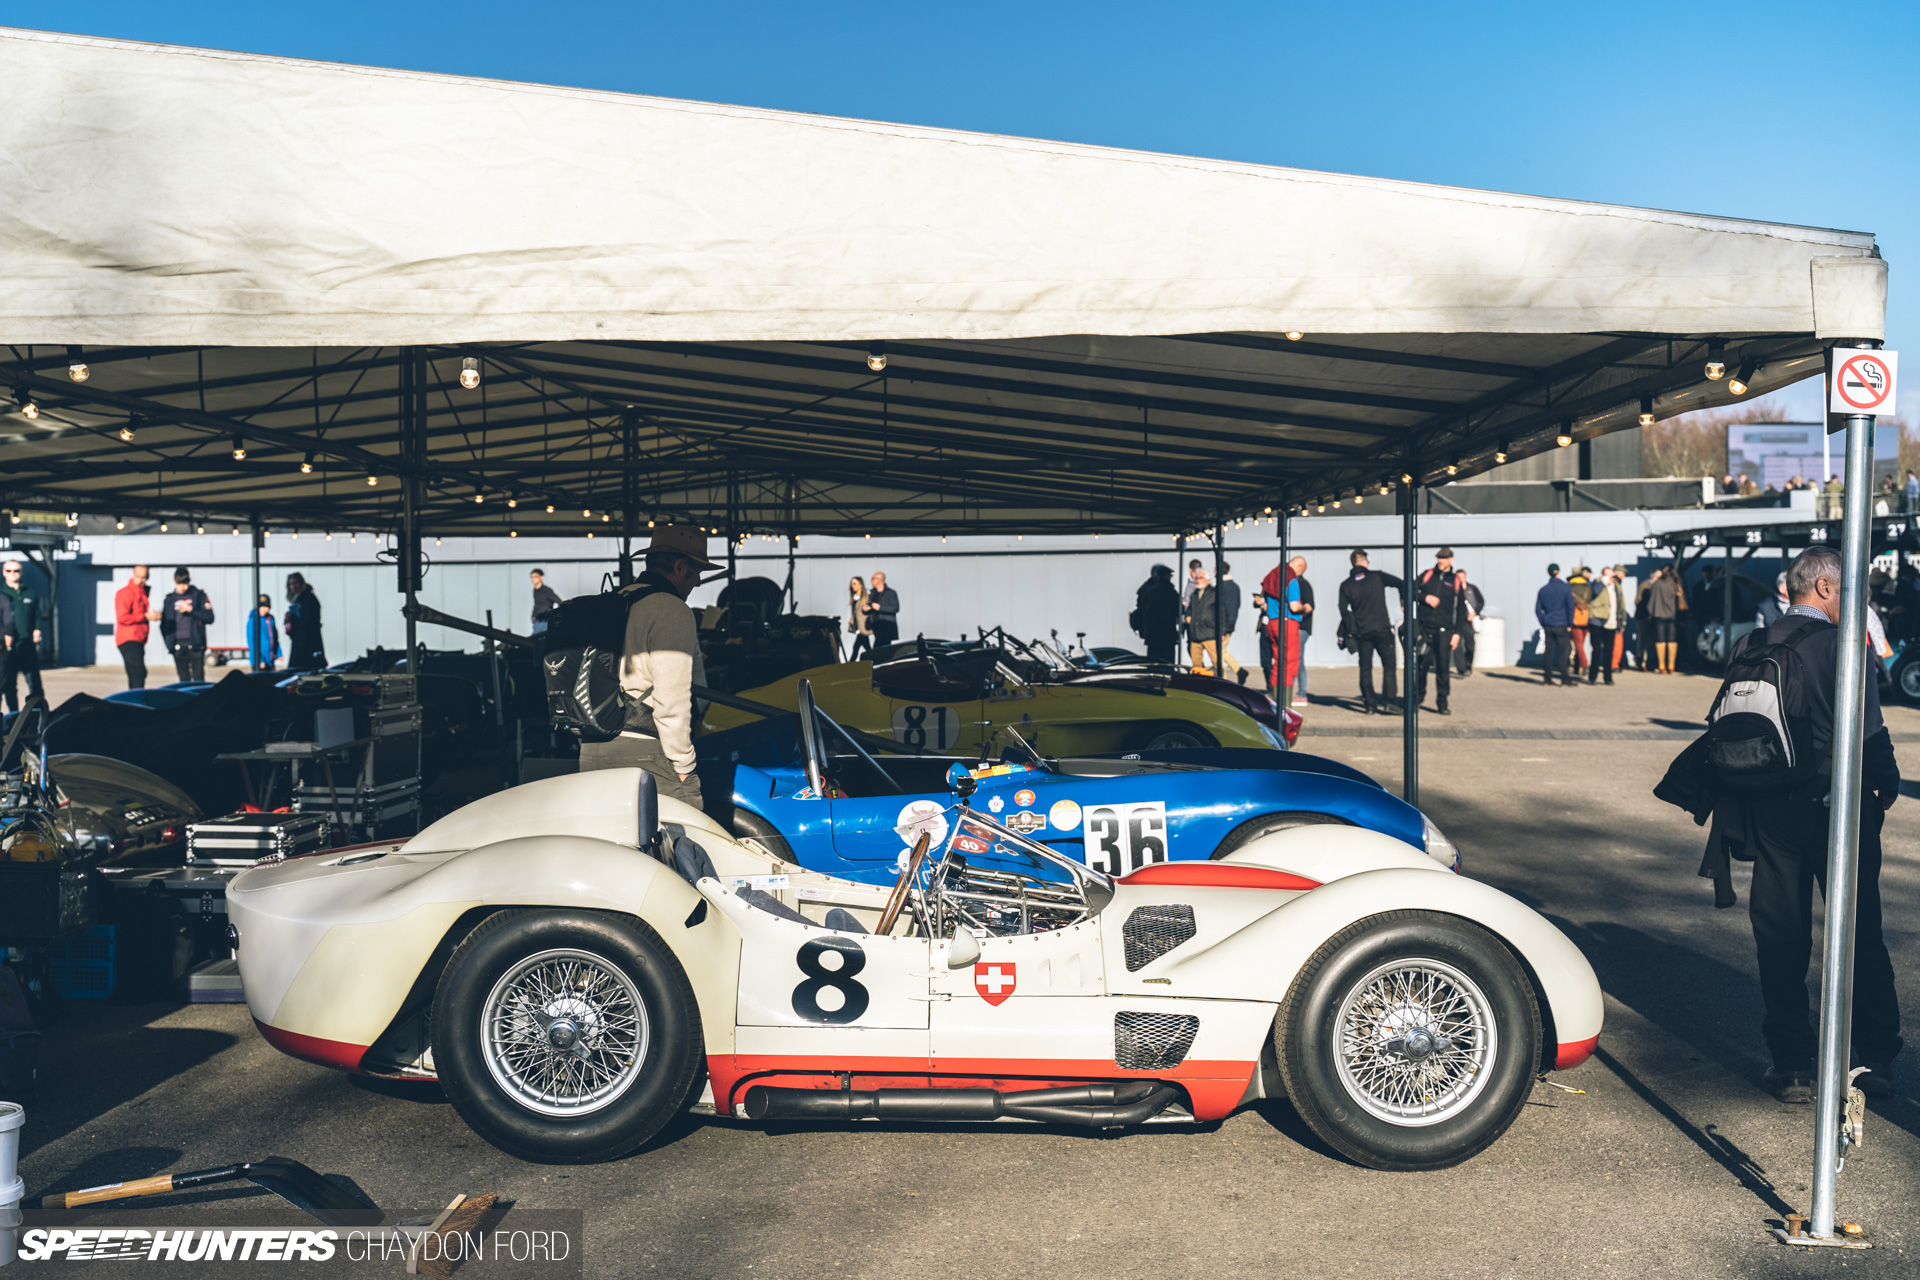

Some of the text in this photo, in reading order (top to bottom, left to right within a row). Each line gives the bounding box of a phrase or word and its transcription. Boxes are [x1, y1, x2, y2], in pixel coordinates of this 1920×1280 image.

[1746, 531, 1762, 543] 25
[1810, 527, 1827, 541] 26
[1887, 523, 1906, 537] 27
[1643, 538, 1658, 549] 23
[1692, 534, 1708, 547] 24
[902, 706, 948, 751] 81
[960, 839, 980, 851] 40
[1090, 807, 1165, 877] 36
[791, 936, 870, 1025] 8
